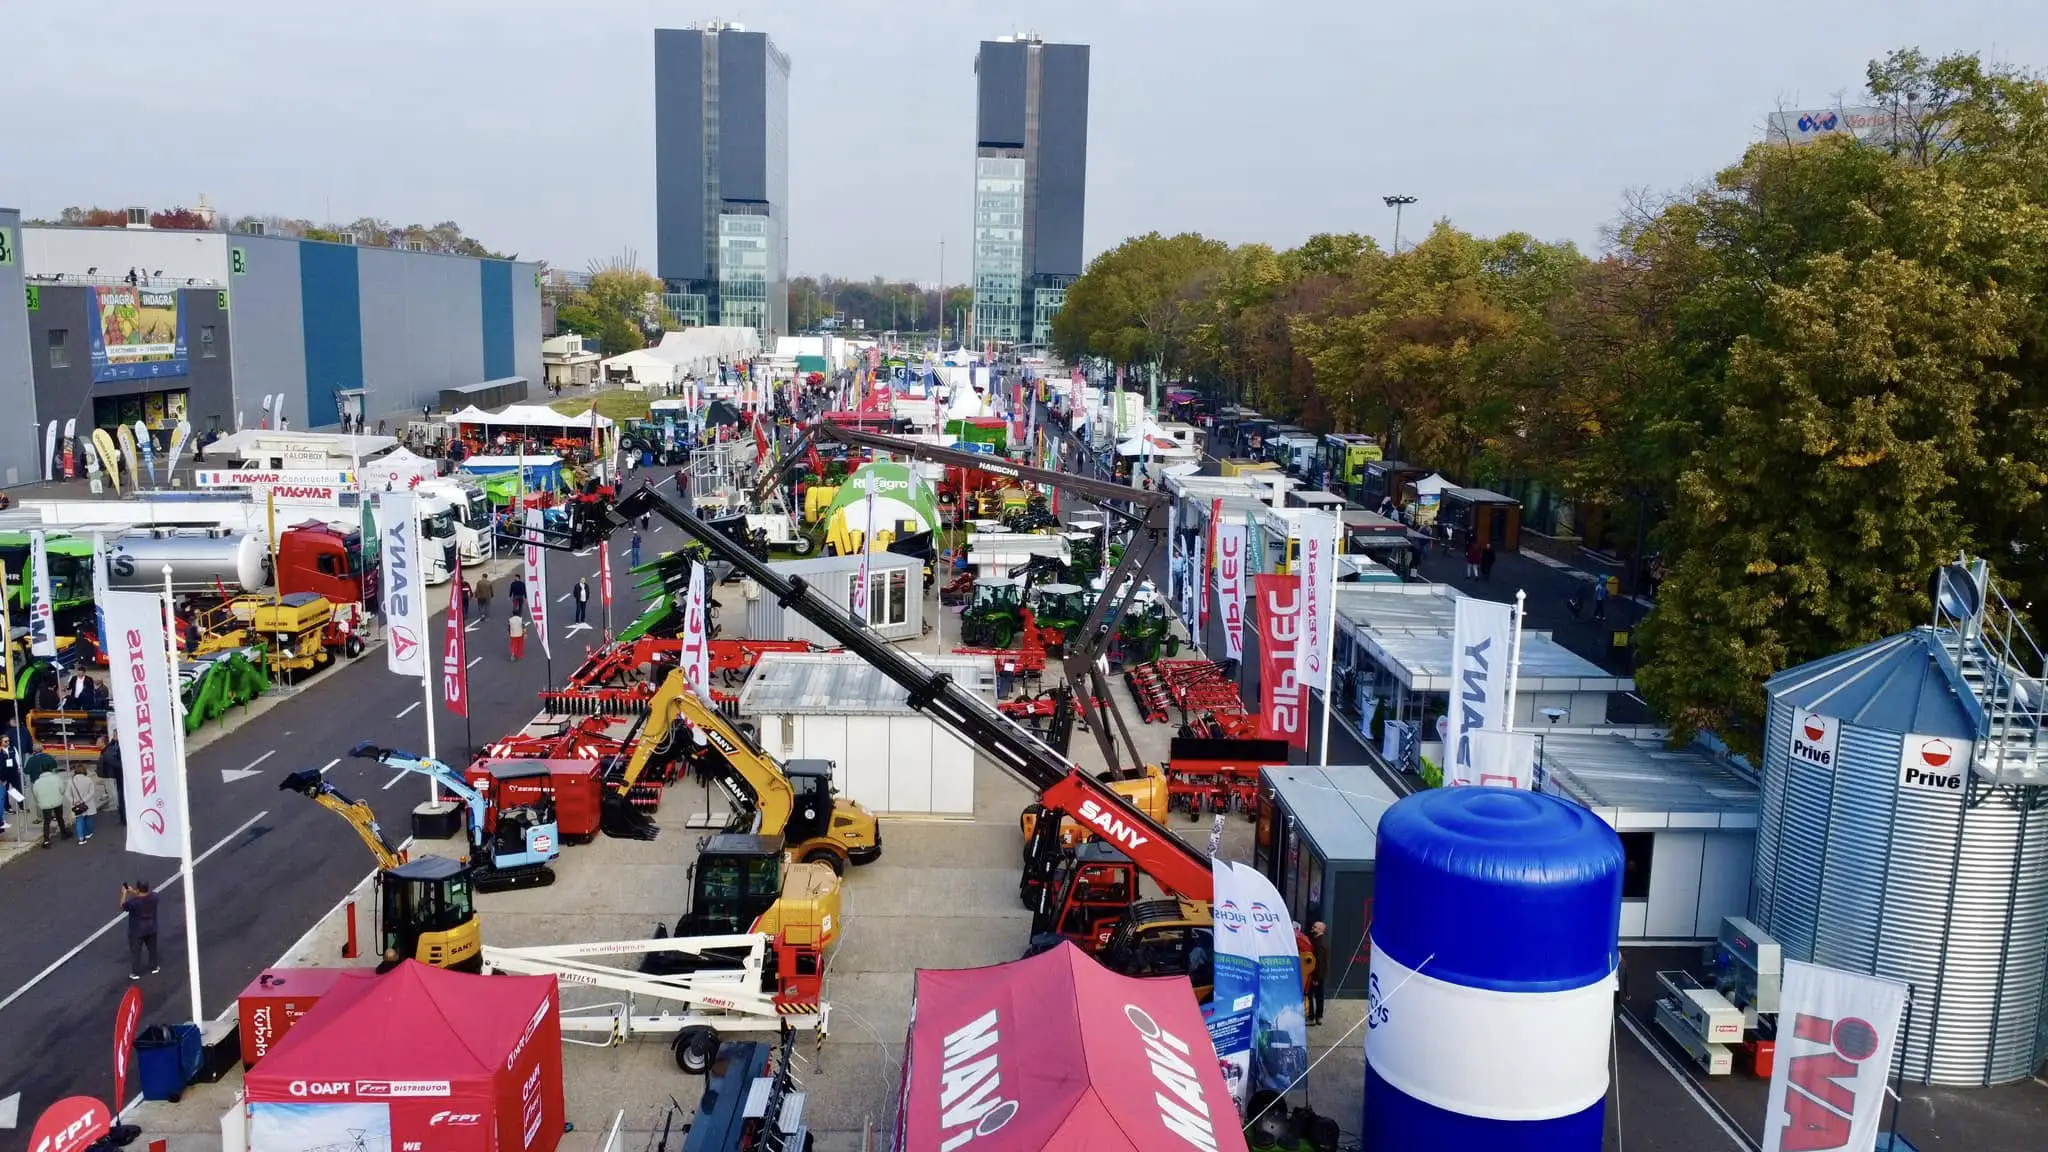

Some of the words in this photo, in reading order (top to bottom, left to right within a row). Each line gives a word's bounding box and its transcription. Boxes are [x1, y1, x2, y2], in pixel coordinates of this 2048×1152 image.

[101, 293, 135, 305] INDAGRA
[143, 294, 174, 306] INDAGRA
[978, 461, 1019, 477] HANGCHA
[232, 473, 279, 483] MAGYAR
[273, 485, 332, 499] MAGYAR
[709, 730, 733, 752] SANY
[1793, 738, 1831, 766] Privé
[1904, 767, 1961, 790] Privé
[725, 776, 748, 802] SANY
[1078, 800, 1149, 850] SANY
[451, 942, 473, 955] SANY
[254, 1009, 268, 1056] Kubota
[310, 1082, 351, 1095] OAPT
[393, 1084, 448, 1093] DISTRIBUTOR
[447, 1113, 481, 1124] FPT
[54, 1108, 95, 1150] FPT
[402, 1141, 422, 1151] WE
